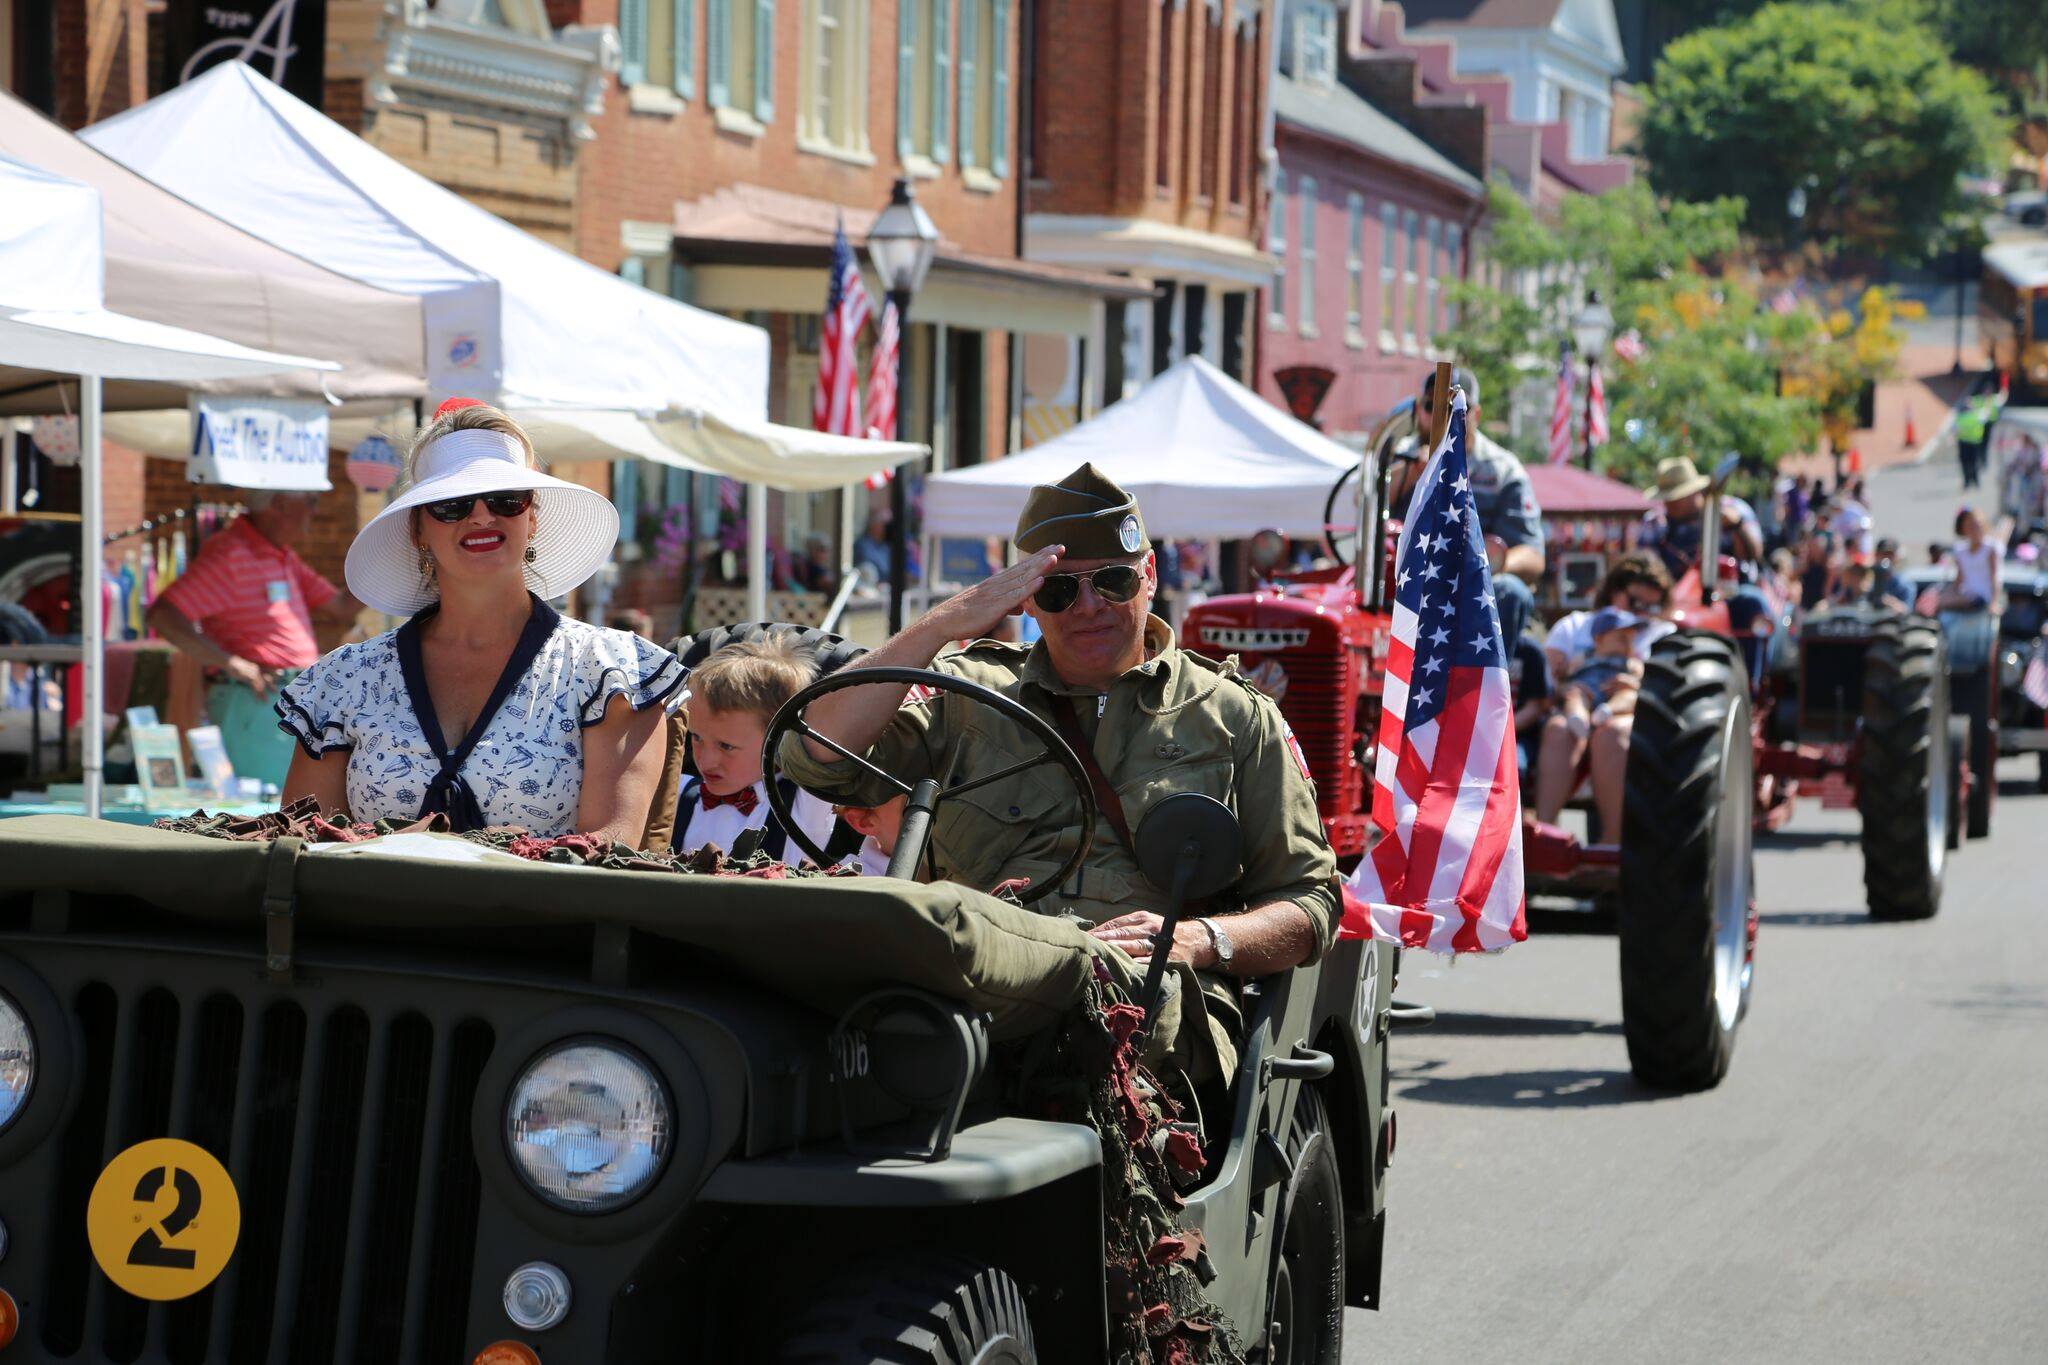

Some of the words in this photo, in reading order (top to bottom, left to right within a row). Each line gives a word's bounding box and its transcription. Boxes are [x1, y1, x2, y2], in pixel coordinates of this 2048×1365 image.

[180, 0, 298, 85] A
[205, 8, 252, 28] Type
[243, 417, 271, 463] The
[126, 1166, 202, 1270] 2
